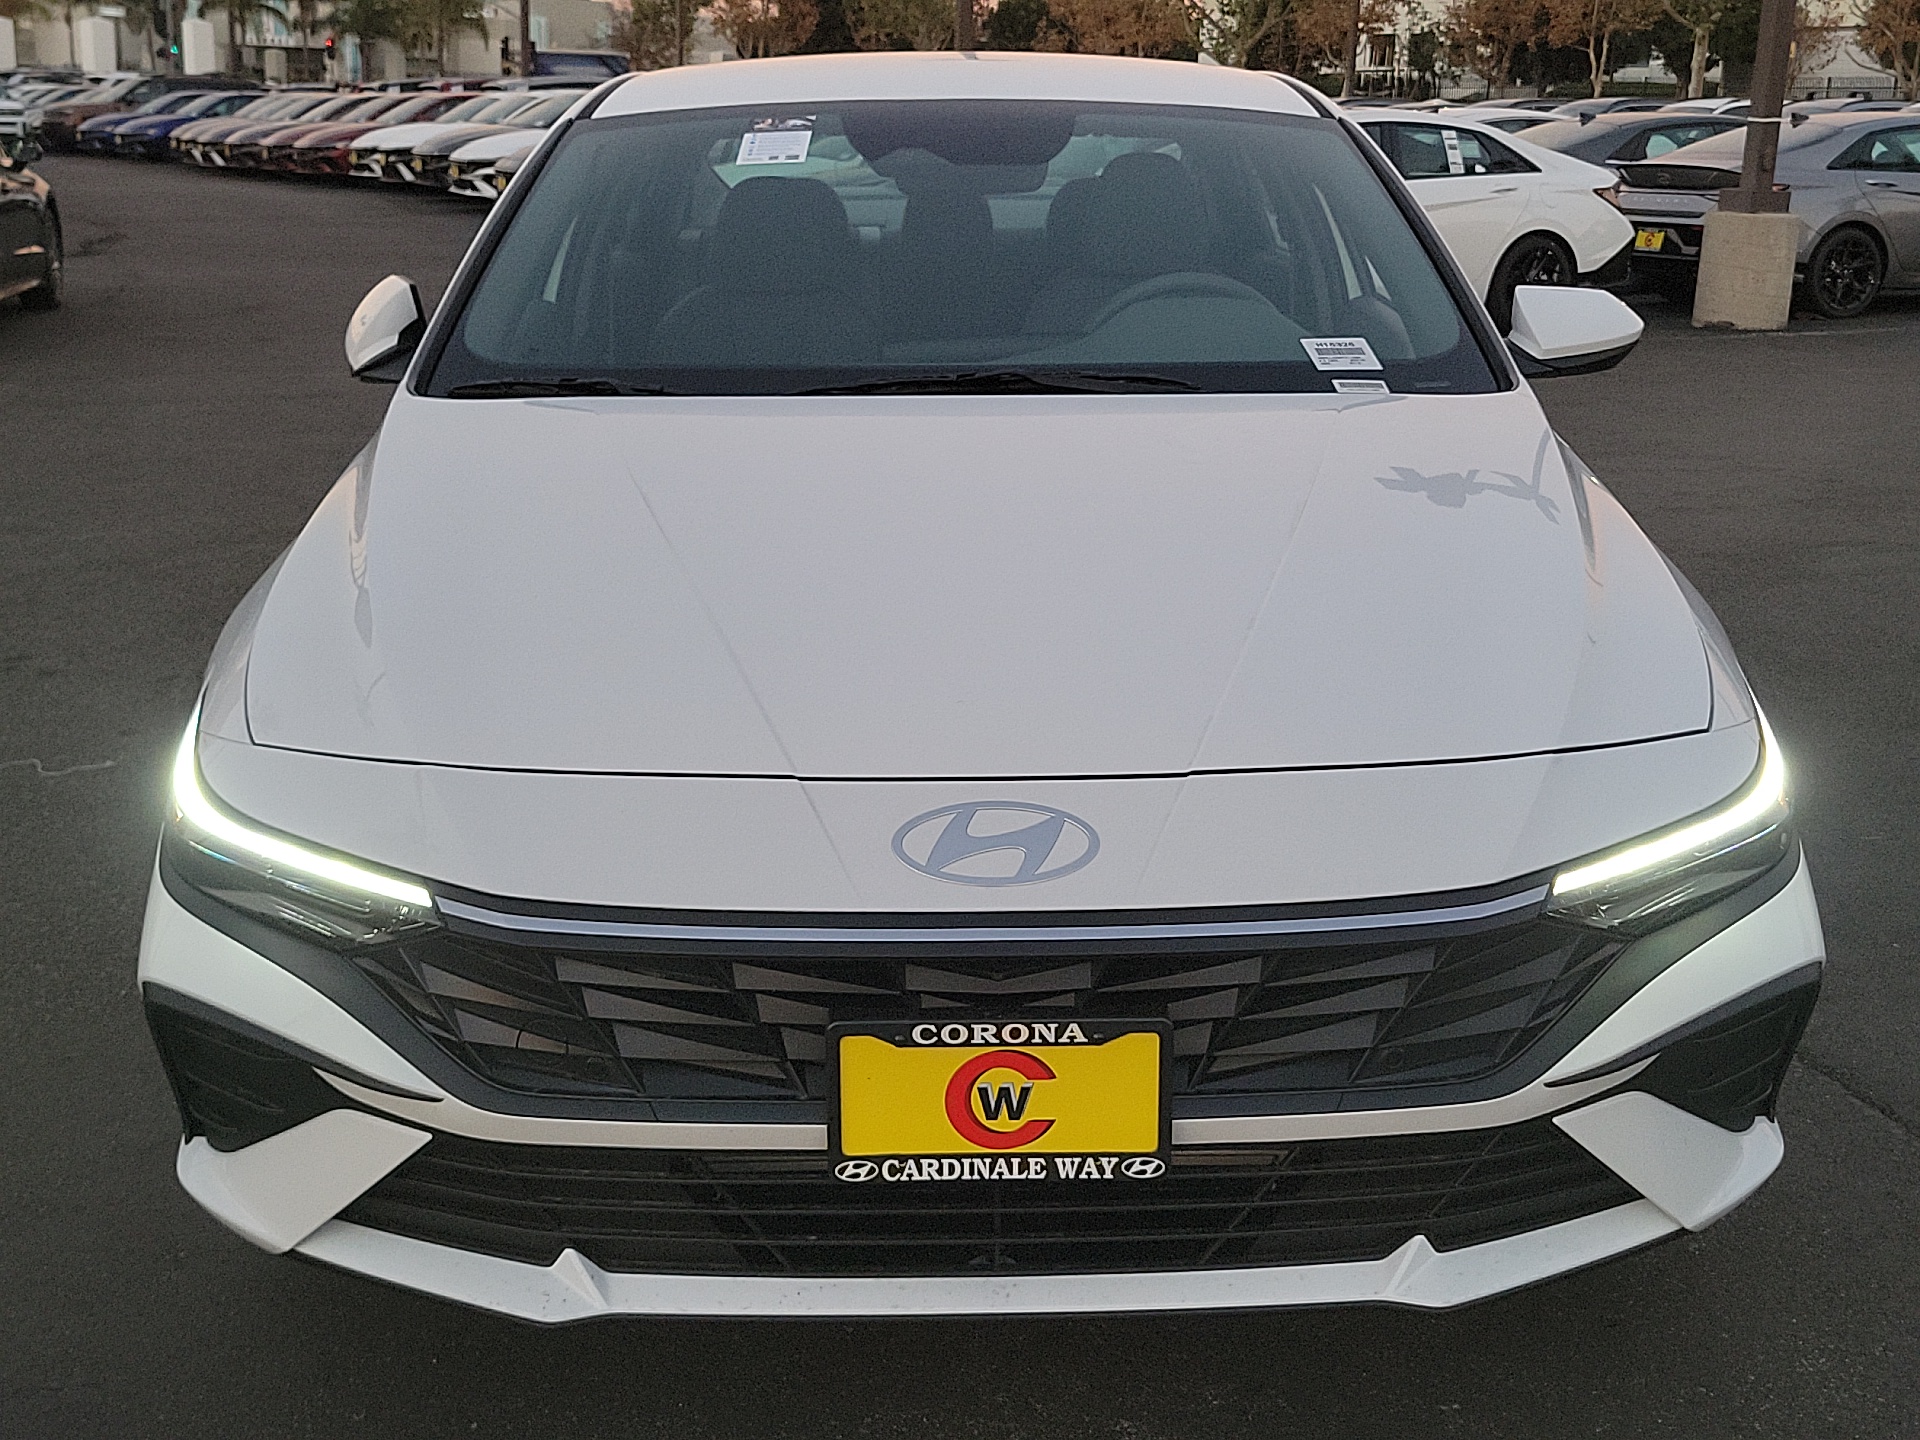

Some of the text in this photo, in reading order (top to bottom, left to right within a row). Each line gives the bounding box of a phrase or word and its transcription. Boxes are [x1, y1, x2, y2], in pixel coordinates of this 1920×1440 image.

[911, 1022, 1089, 1045] CORONA
[881, 1157, 1121, 1182] CARDINALE WAY
